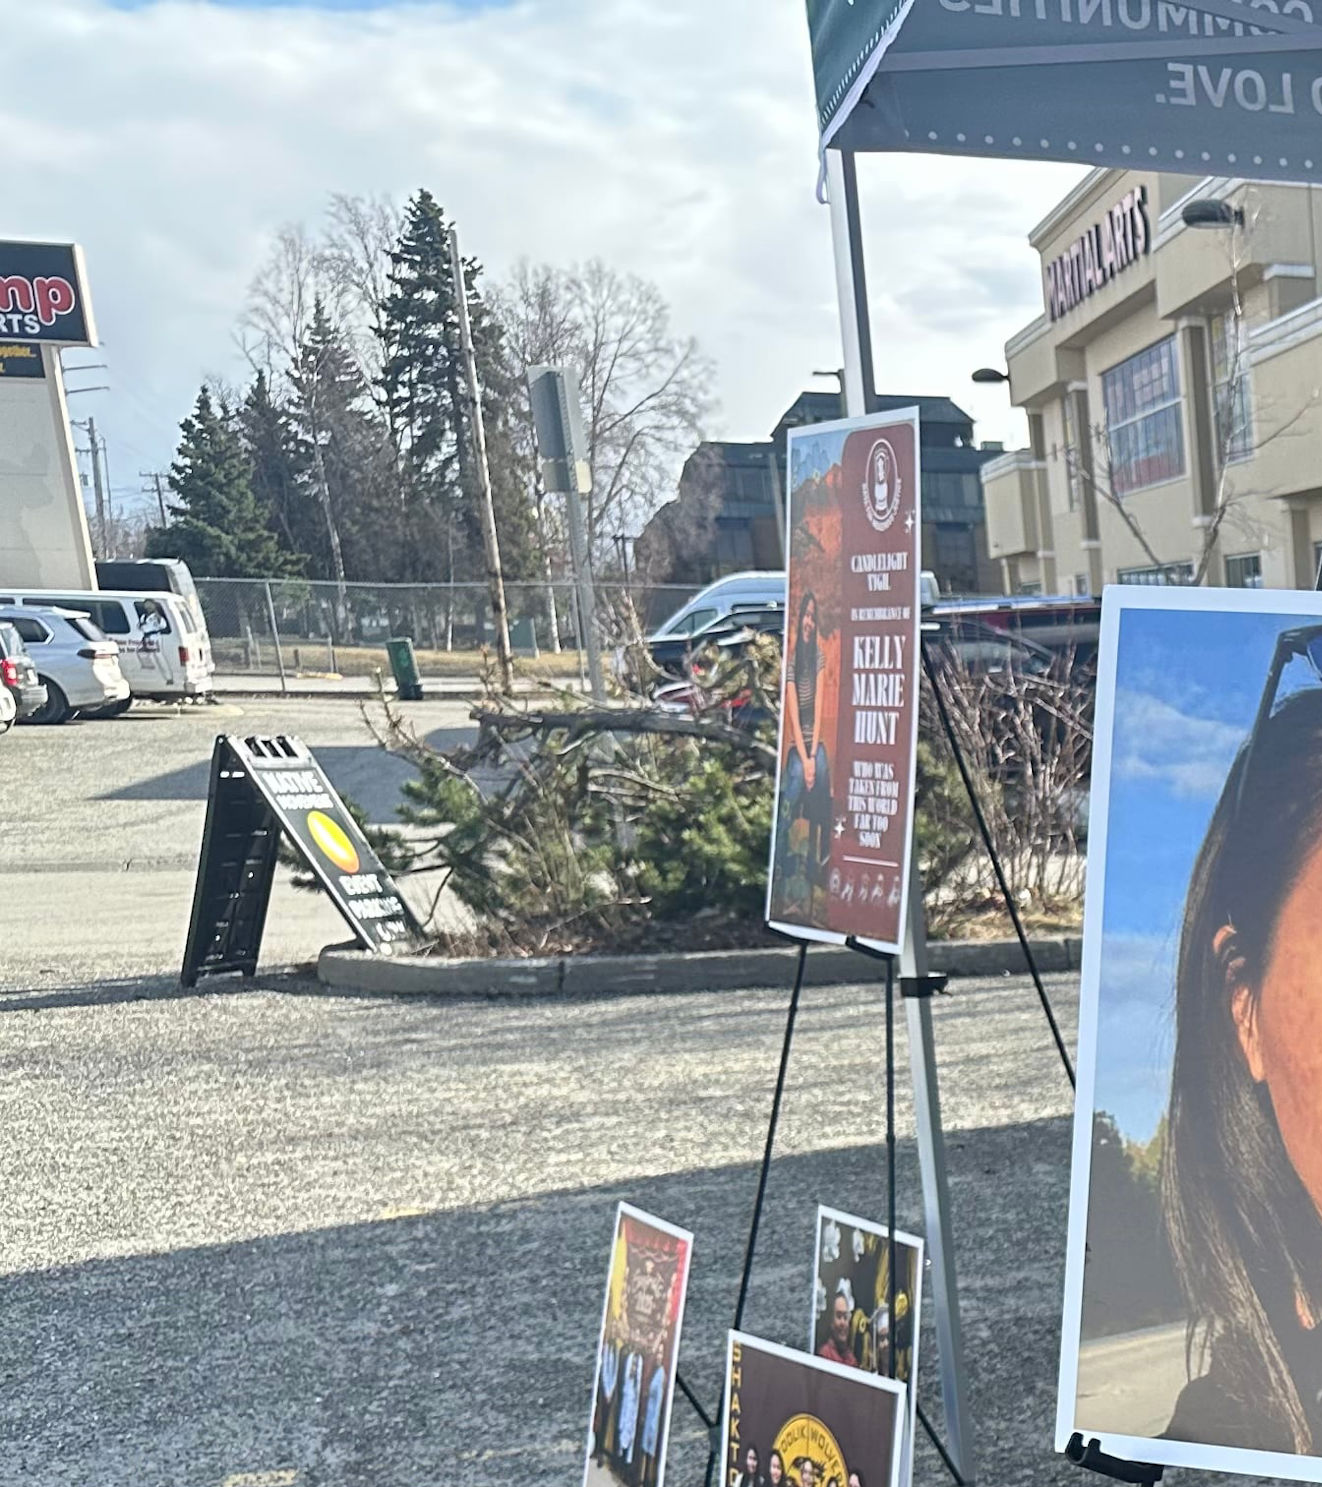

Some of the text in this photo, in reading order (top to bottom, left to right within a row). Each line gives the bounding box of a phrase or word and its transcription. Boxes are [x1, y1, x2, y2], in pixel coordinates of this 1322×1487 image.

[1047, 185, 1149, 322] MARTIAL ARTS
[851, 552, 908, 574] CANDLELIGHT
[853, 635, 907, 670] KELLY
[851, 673, 906, 708] MARIE
[854, 710, 899, 745] HUNT
